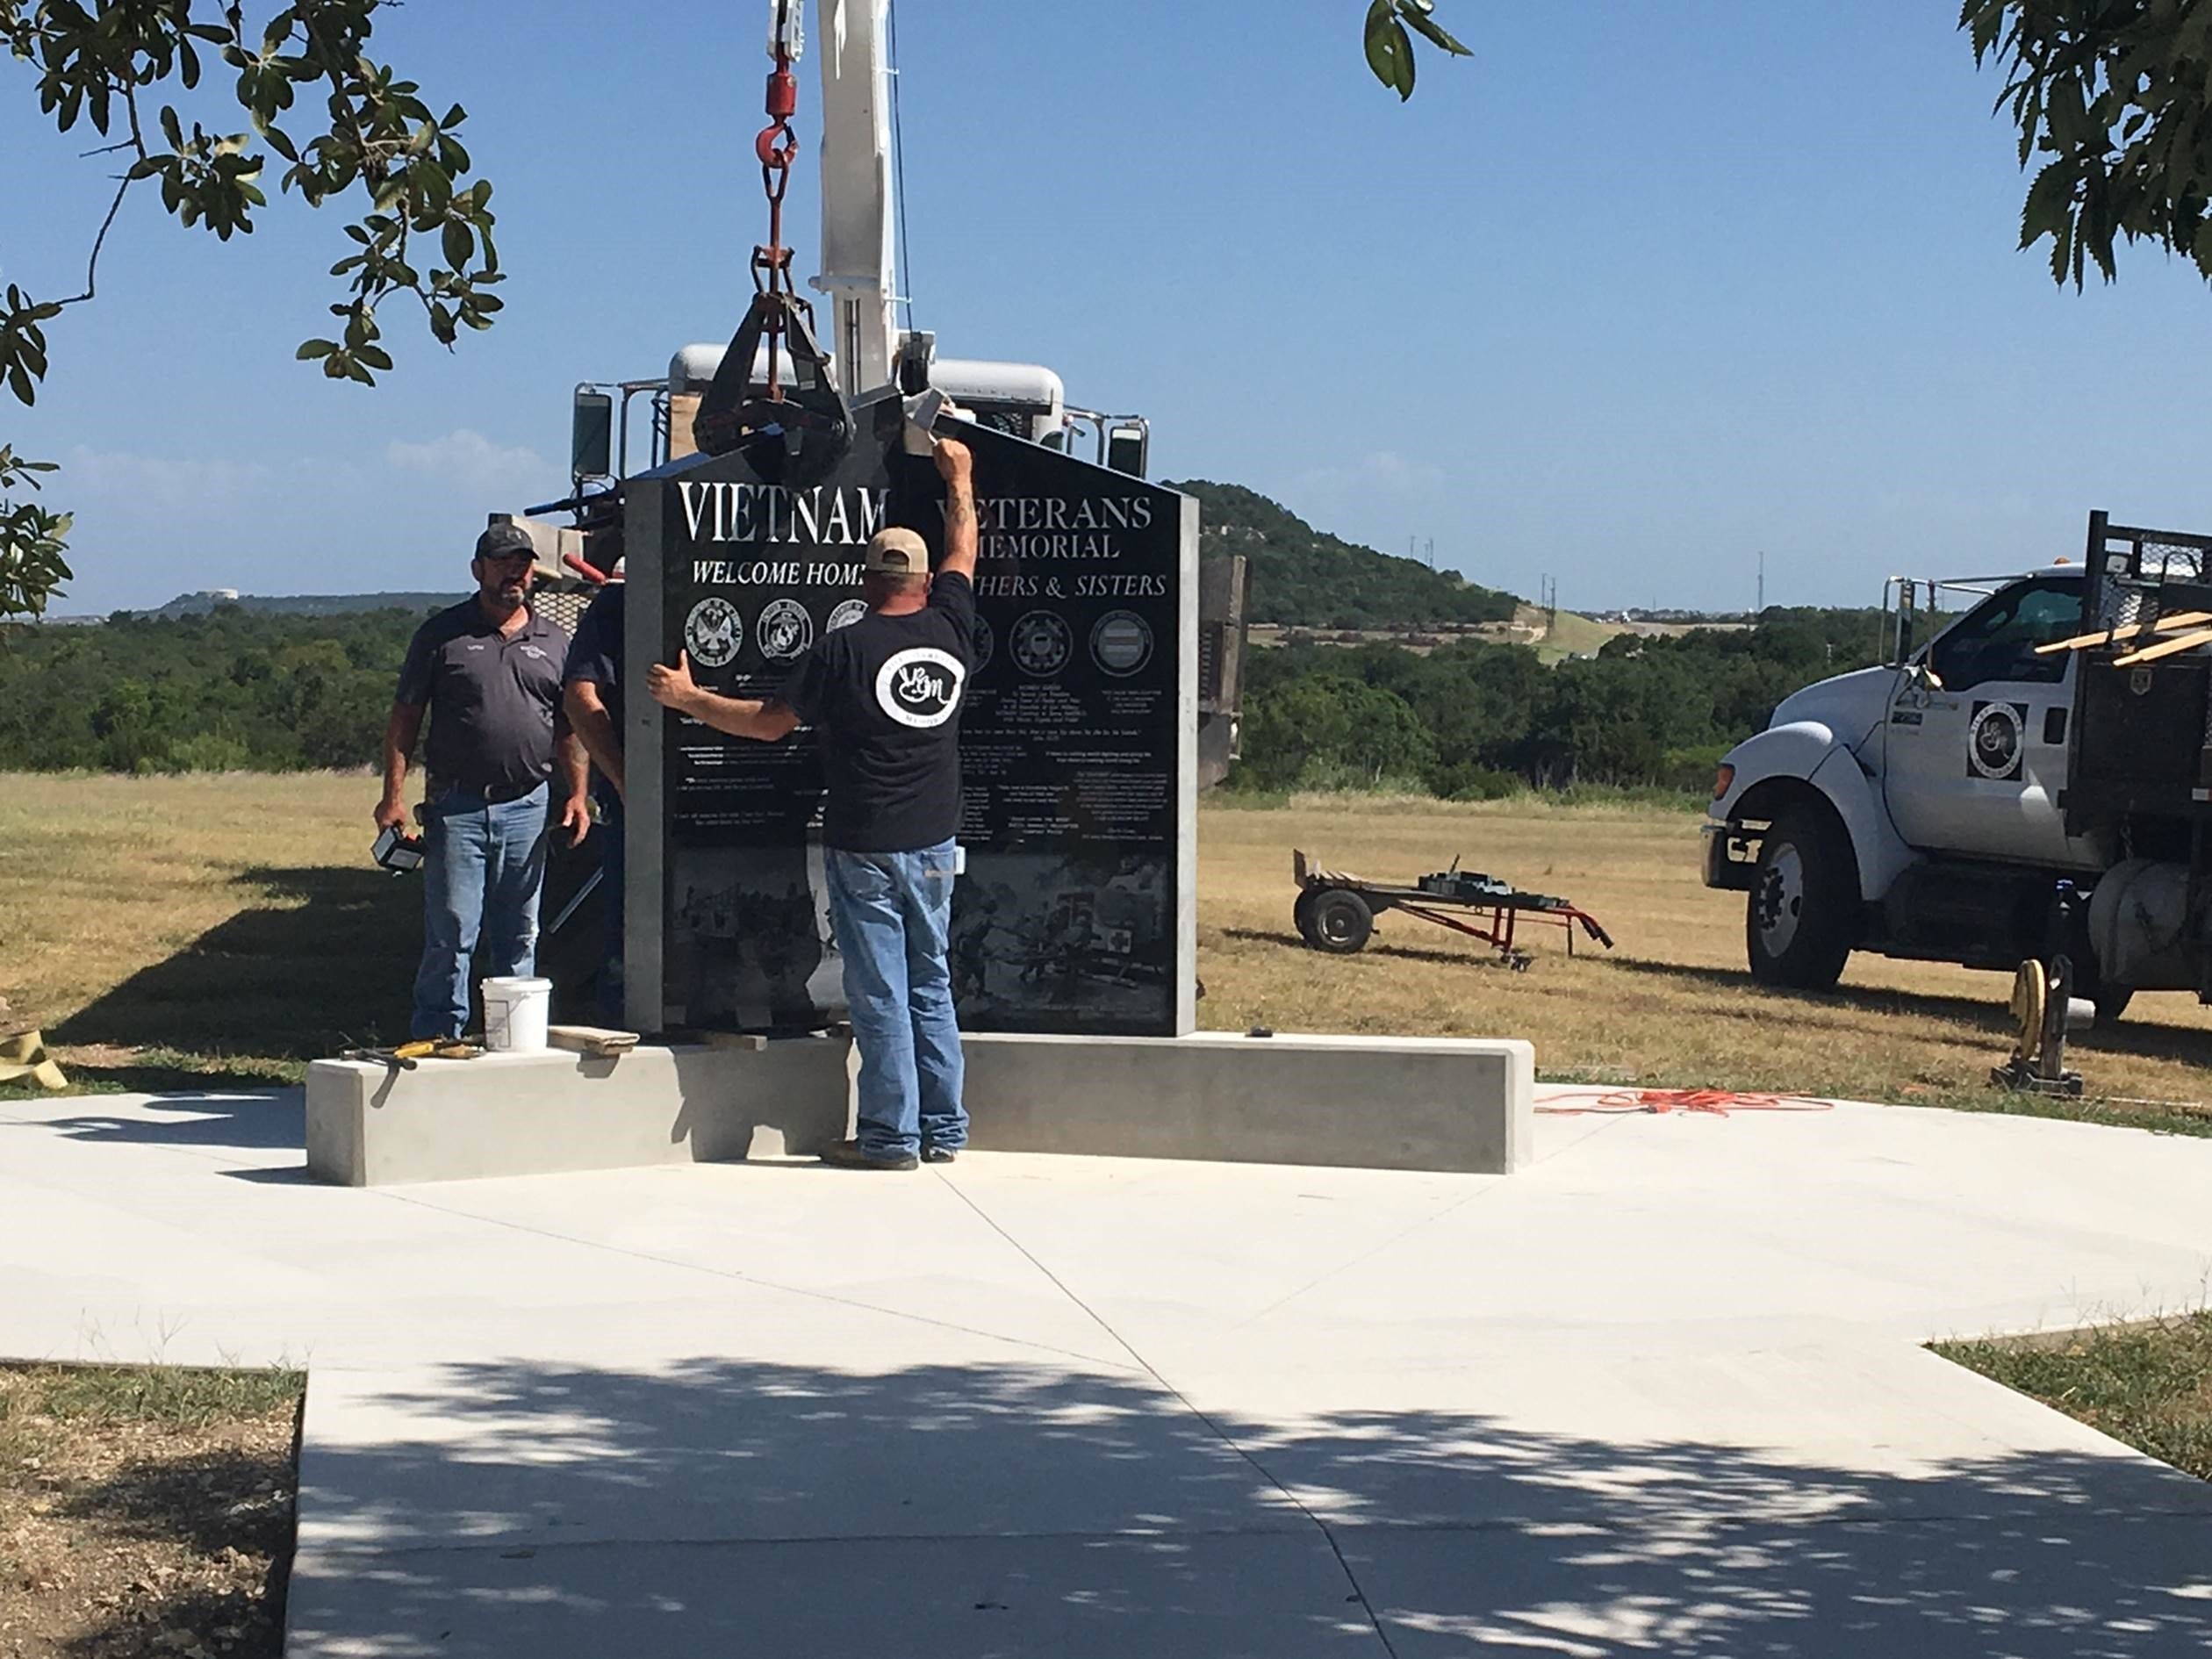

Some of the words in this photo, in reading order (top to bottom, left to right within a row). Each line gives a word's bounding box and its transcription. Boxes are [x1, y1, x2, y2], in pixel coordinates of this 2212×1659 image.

[678, 481, 891, 545] VIETNAM
[693, 560, 801, 585] WELCOME
[973, 574, 1039, 597] HERS
[1045, 575, 1067, 600] &
[1075, 574, 1167, 597] SISTERS
